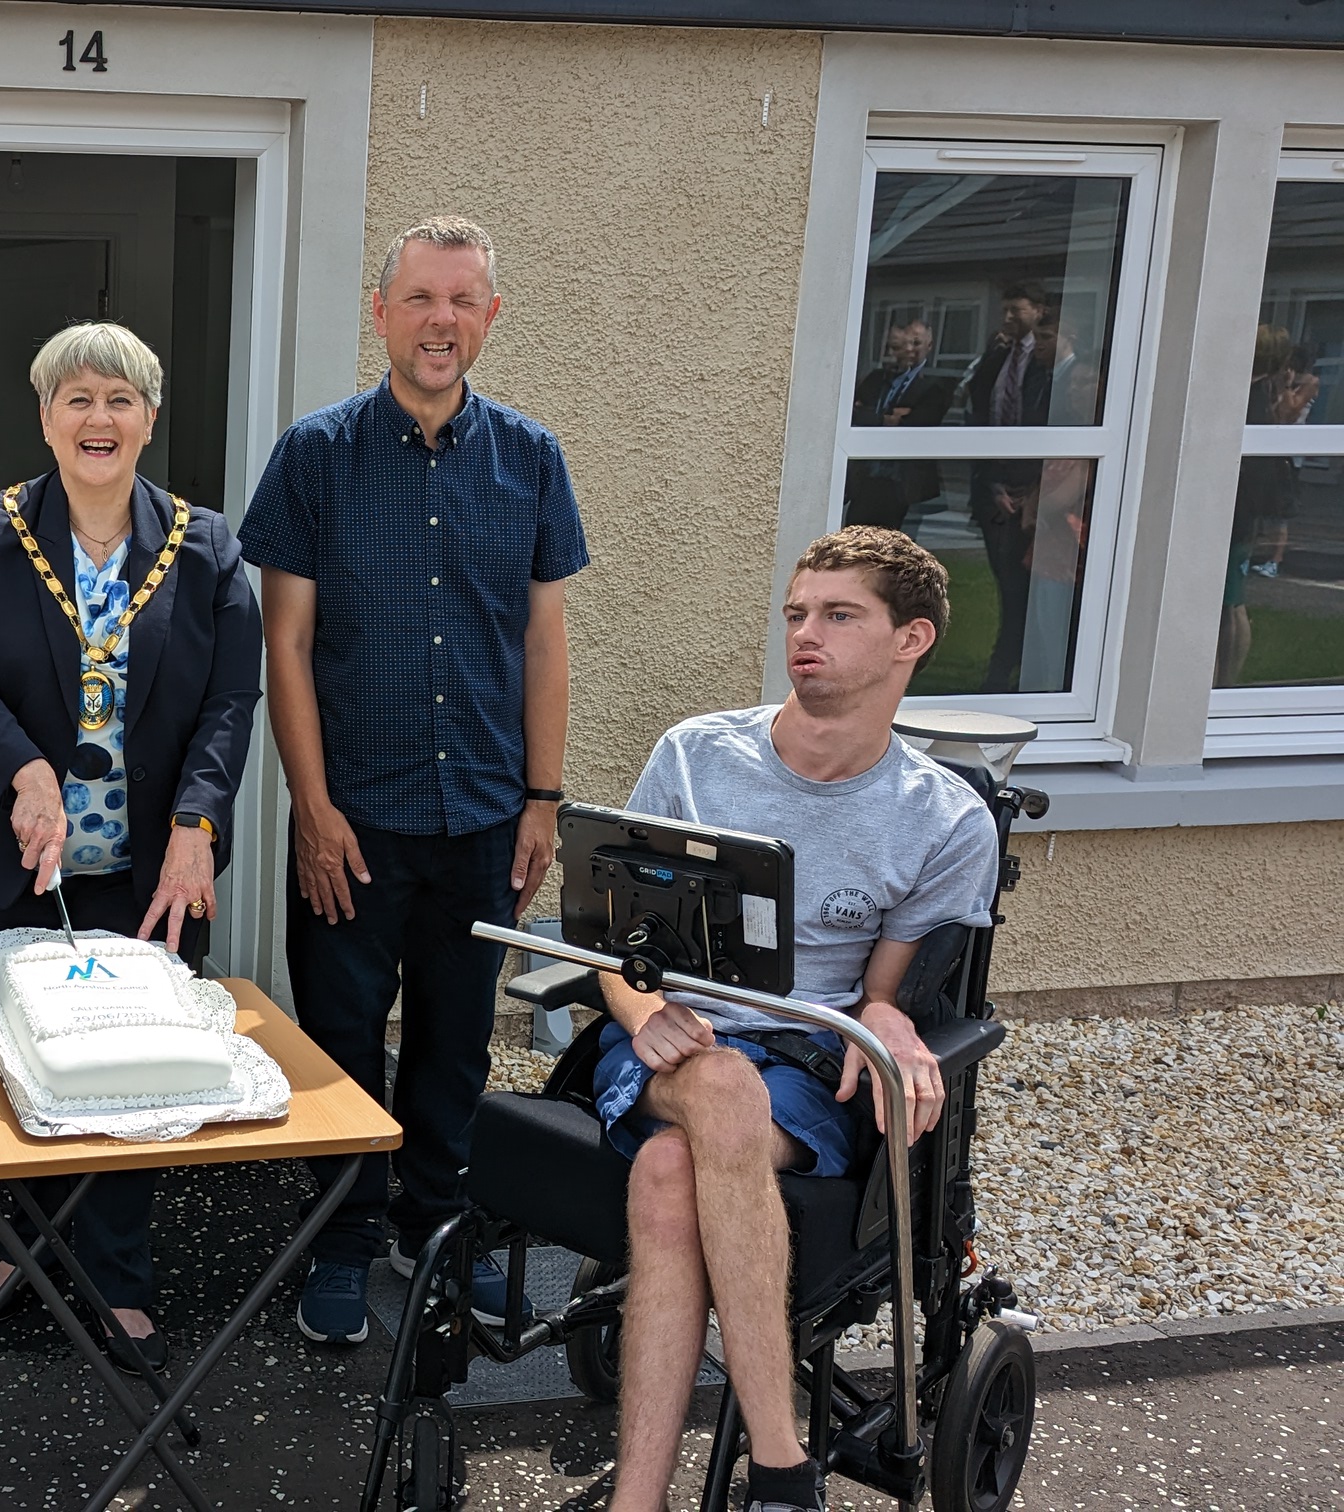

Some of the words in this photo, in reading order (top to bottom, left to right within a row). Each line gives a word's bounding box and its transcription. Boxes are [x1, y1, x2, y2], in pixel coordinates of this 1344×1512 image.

[58, 29, 108, 72] 14
[829, 892, 841, 902] OFF
[862, 895, 874, 912] WALL
[836, 906, 862, 919] VANS
